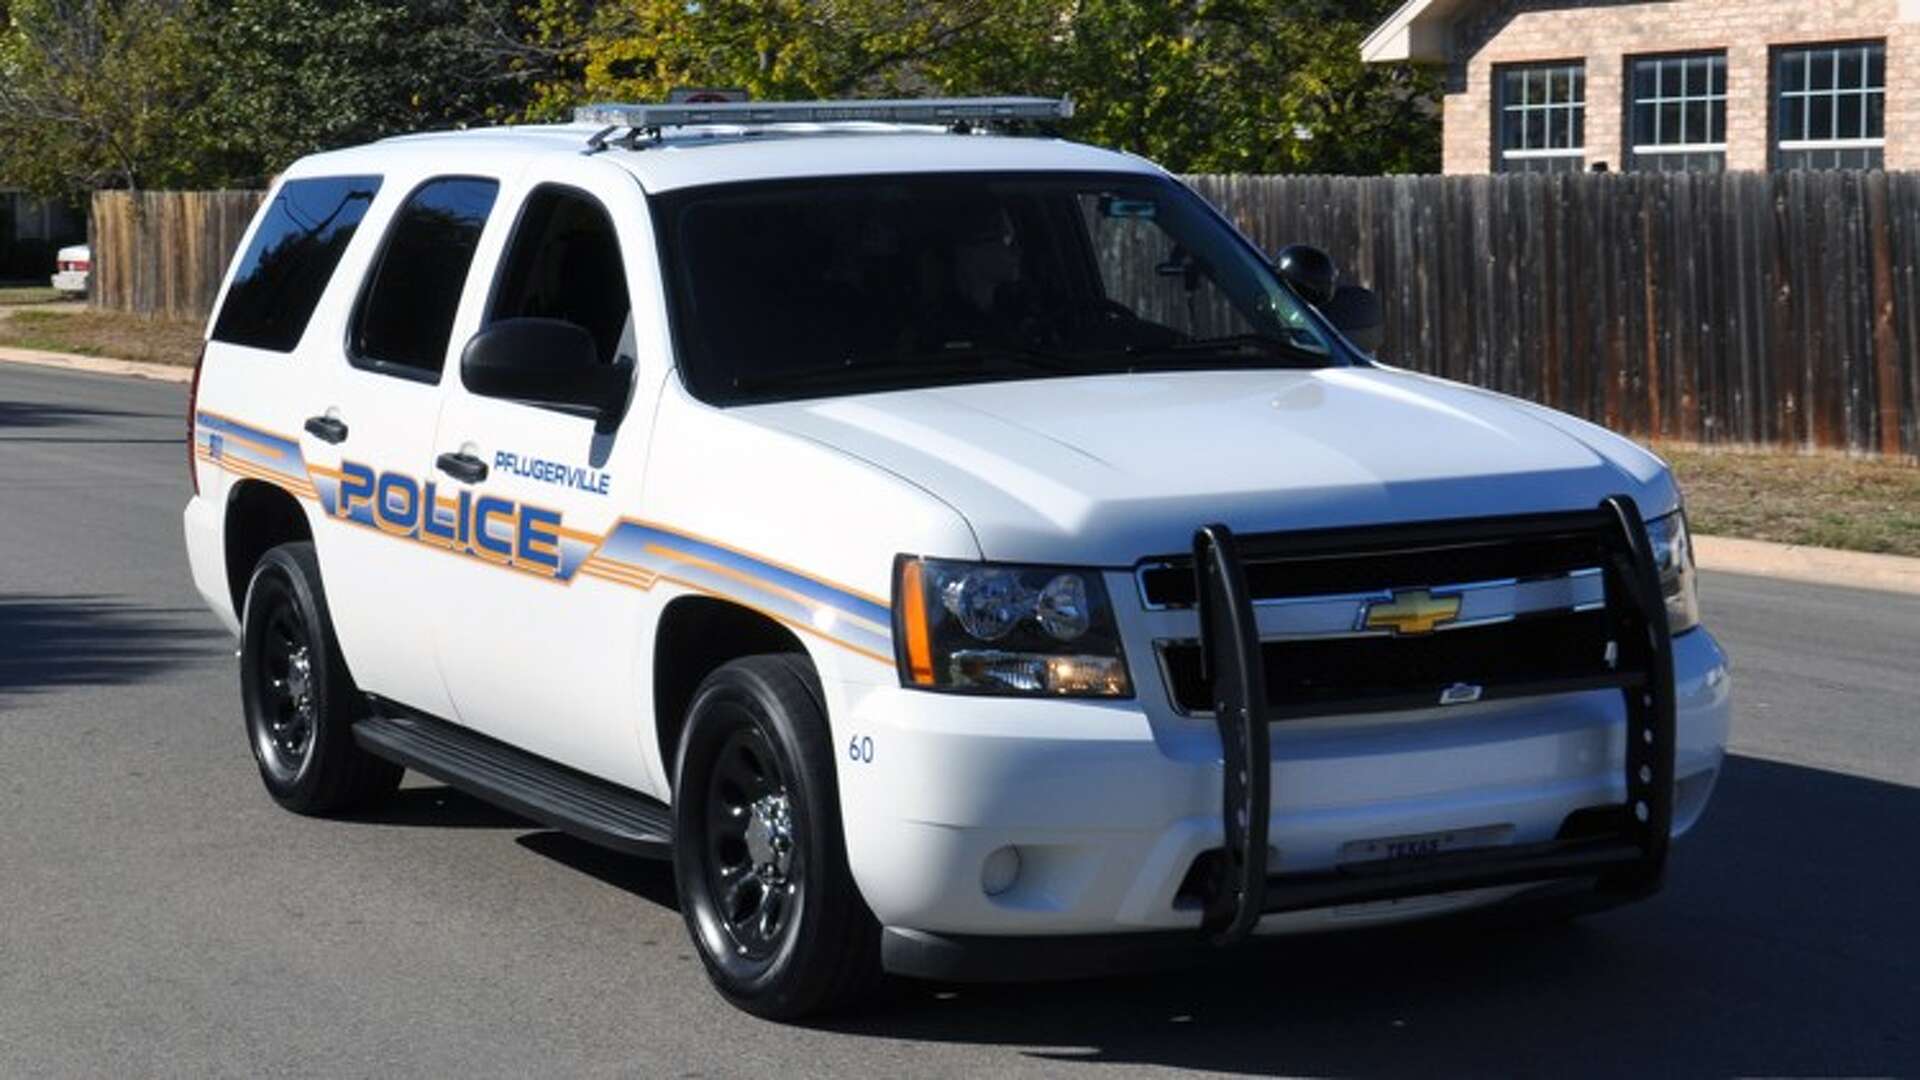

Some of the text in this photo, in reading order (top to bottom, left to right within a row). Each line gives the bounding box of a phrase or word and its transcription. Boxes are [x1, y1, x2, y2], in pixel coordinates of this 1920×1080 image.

[494, 451, 611, 495] PFLUGERVILLE
[340, 461, 562, 569] POLICE
[849, 734, 874, 763] 60
[1387, 838, 1440, 859] TEXAS
